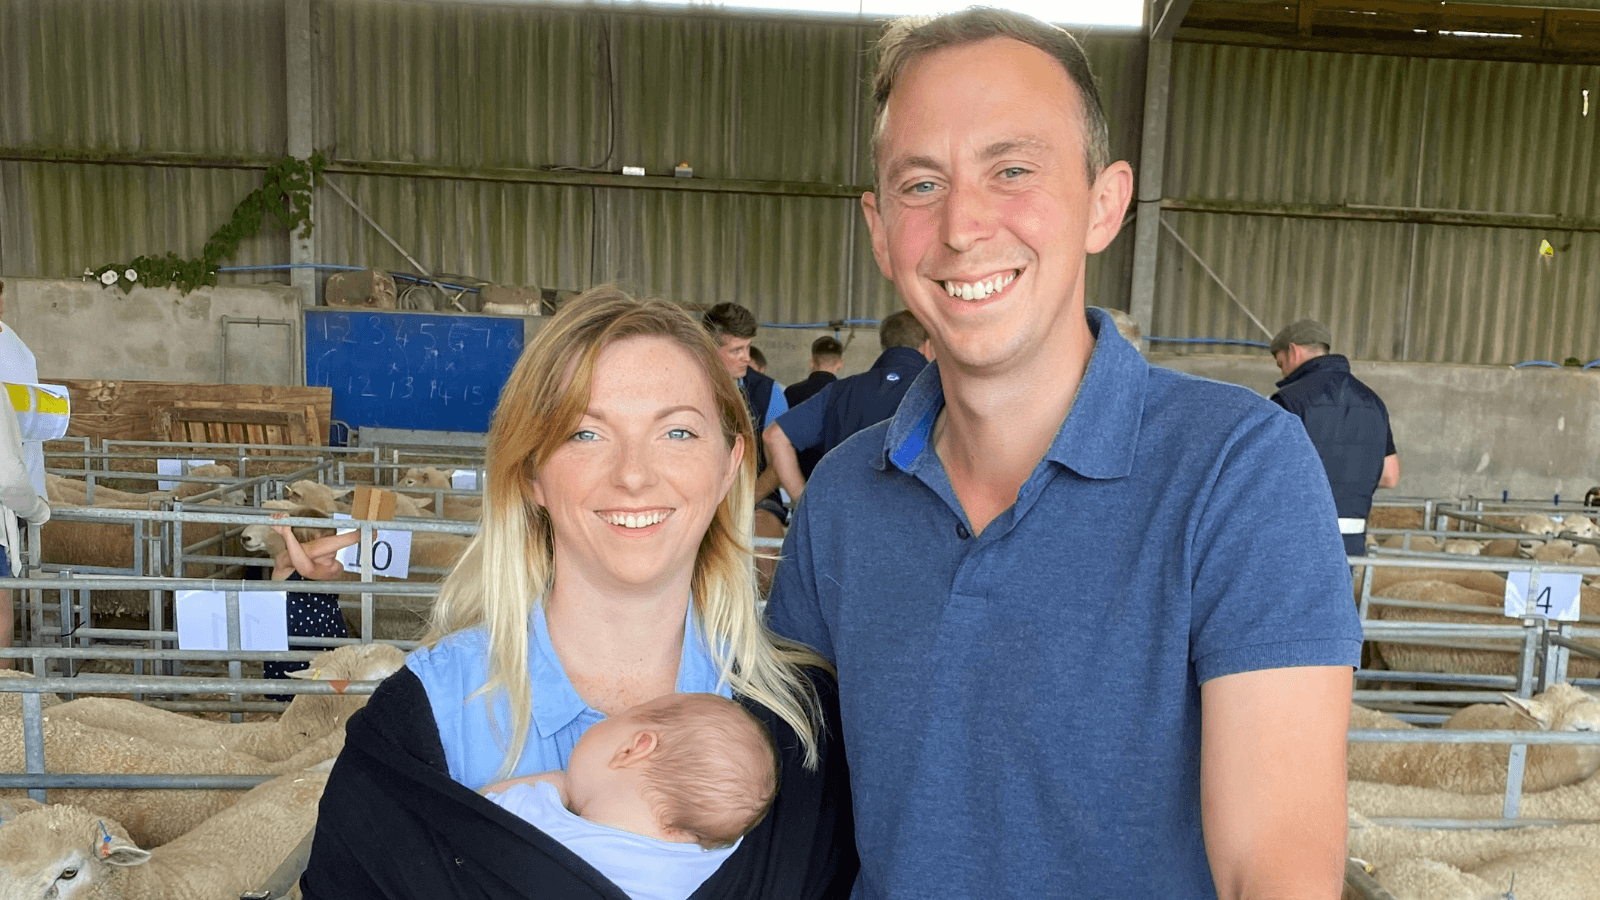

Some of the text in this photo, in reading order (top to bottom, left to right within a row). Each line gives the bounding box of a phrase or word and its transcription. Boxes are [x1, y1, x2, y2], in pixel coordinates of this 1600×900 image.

[337, 315, 358, 344] 2
[368, 315, 386, 345] 3
[395, 319, 409, 347] 4
[419, 323, 437, 350] 5
[472, 328, 492, 349] 7
[348, 375, 377, 397] 12
[389, 376, 415, 399] 13
[429, 379, 453, 406] 14
[463, 385, 485, 406] 15
[348, 540, 393, 571] 10
[1536, 586, 1553, 615] 4
